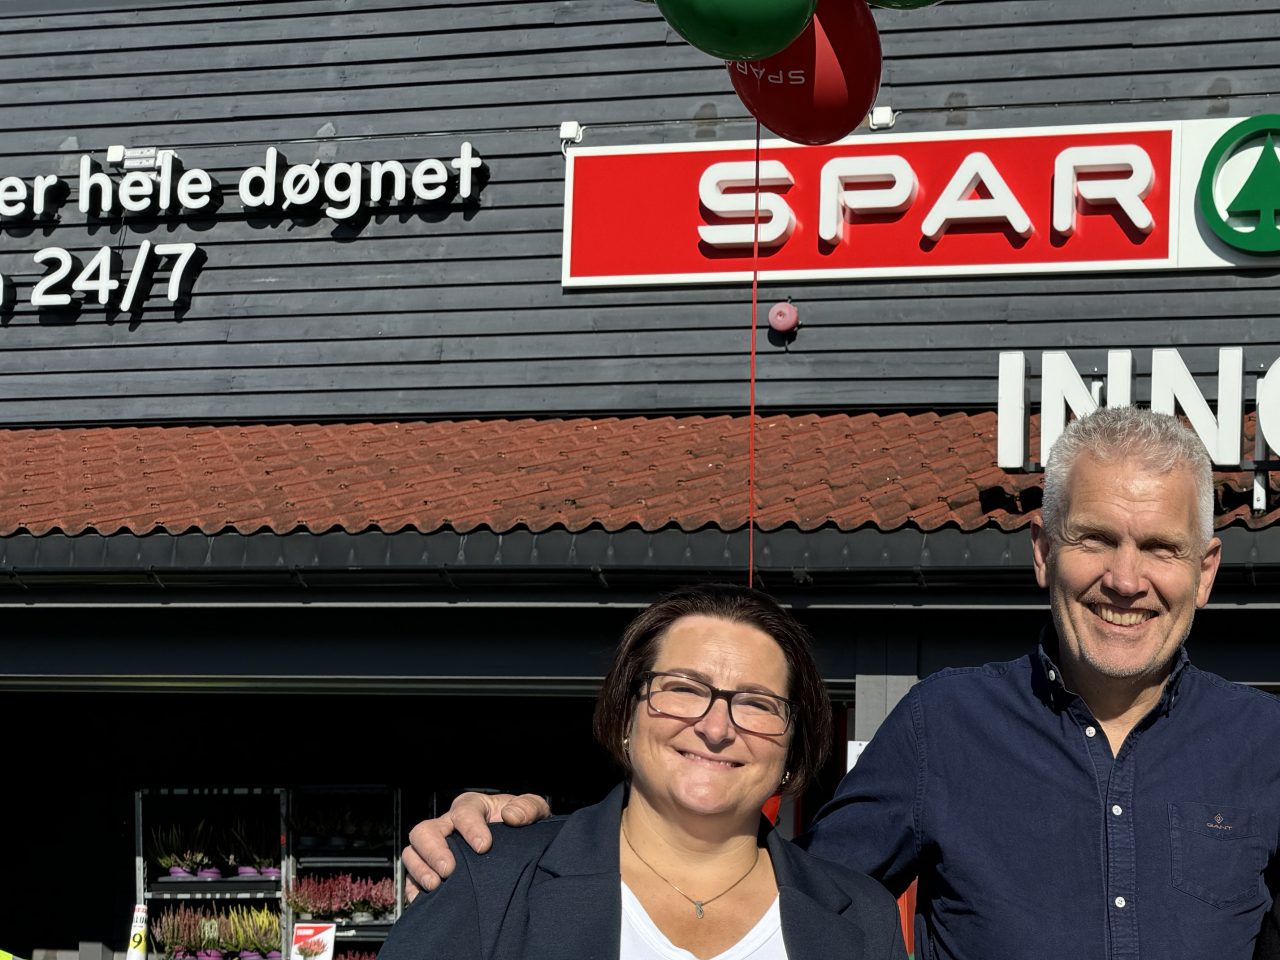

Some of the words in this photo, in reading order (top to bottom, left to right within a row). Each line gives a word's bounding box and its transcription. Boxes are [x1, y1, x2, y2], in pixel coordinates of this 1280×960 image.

[78, 153, 213, 213] hele
[238, 141, 482, 219] døgnet
[697, 144, 1157, 250] SPAR
[31, 239, 197, 312] 24/7
